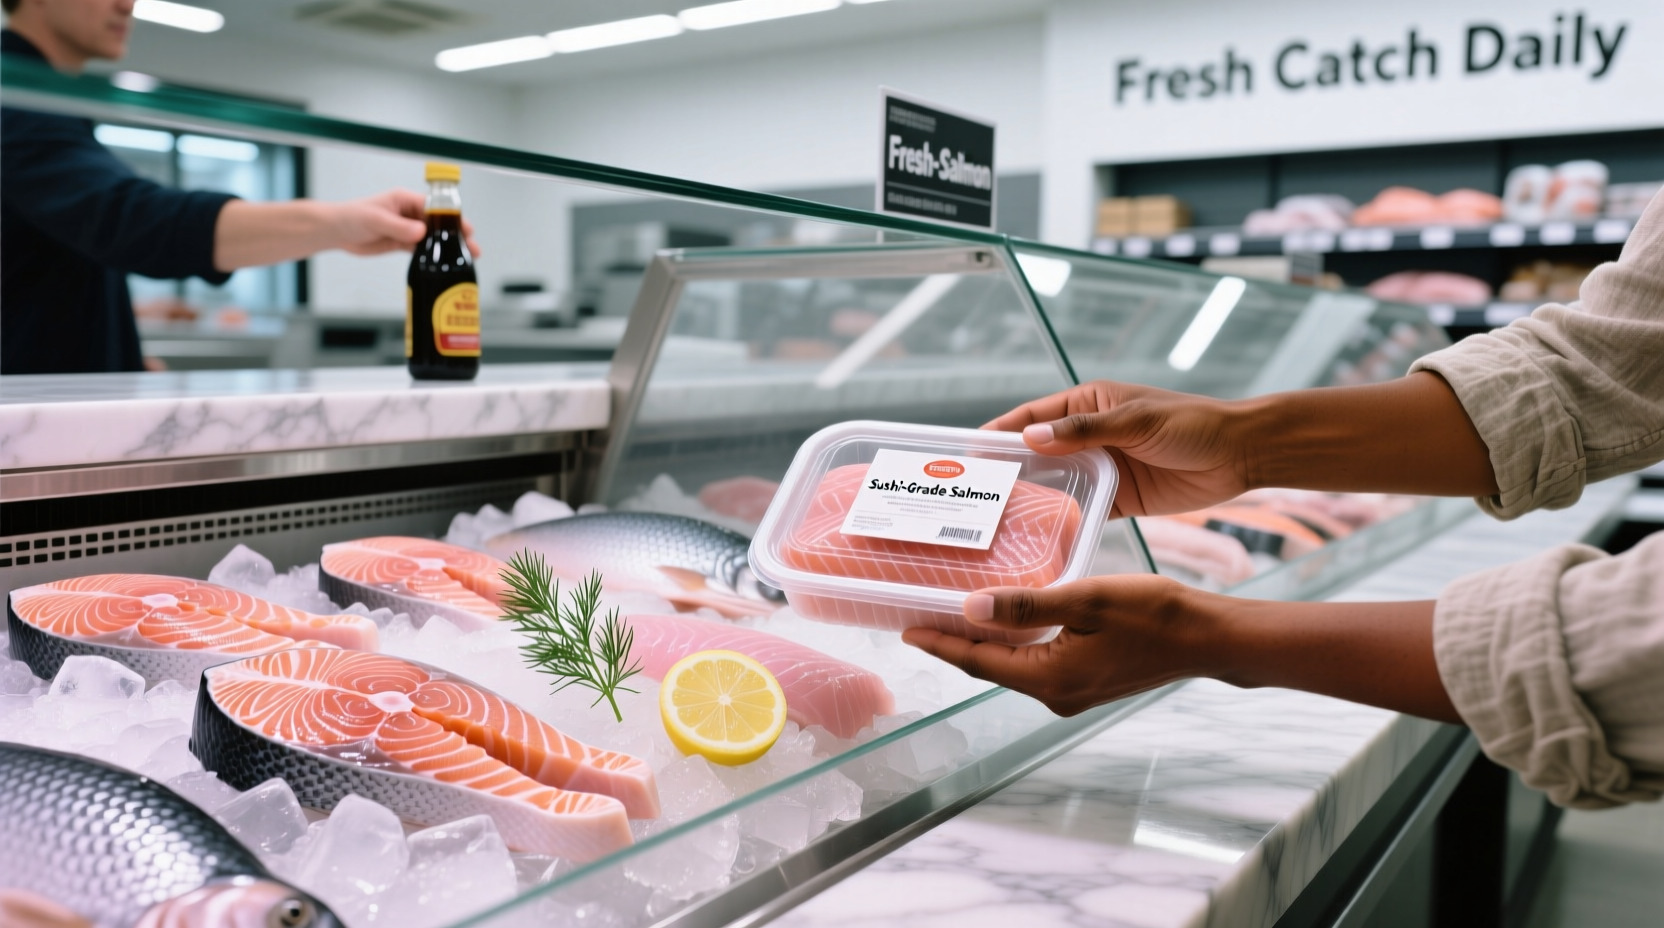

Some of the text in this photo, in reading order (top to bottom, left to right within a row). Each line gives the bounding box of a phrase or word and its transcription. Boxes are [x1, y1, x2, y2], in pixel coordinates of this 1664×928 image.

[1114, 12, 1627, 102] Fresh Catch Daily
[888, 134, 992, 190] Fresh-Salmon
[868, 478, 1000, 501] Sushi-Grade Salmon
